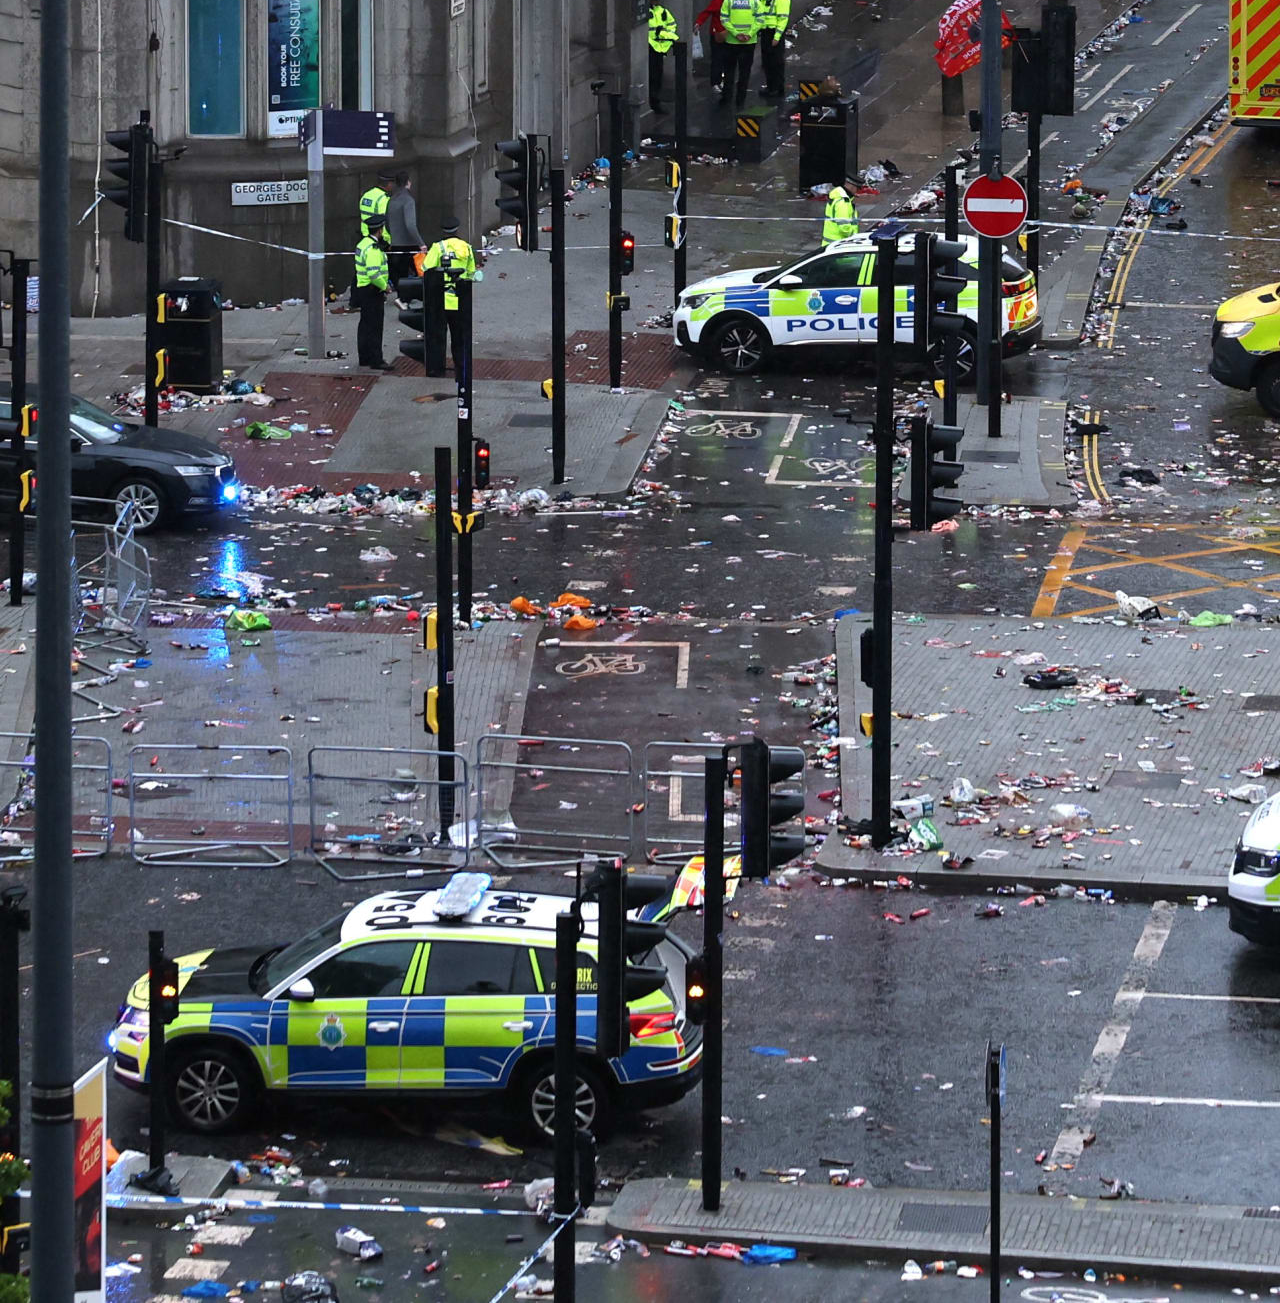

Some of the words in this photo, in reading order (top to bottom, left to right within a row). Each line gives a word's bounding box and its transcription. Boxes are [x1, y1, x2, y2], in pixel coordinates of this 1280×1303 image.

[280, 67, 288, 88] BOOK
[289, 62, 301, 87] FREE
[235, 184, 282, 194] GEORGES
[286, 182, 308, 191] DOC
[257, 193, 289, 202] GATES
[366, 903, 417, 927] 05
[82, 1145, 101, 1175] CLUB
